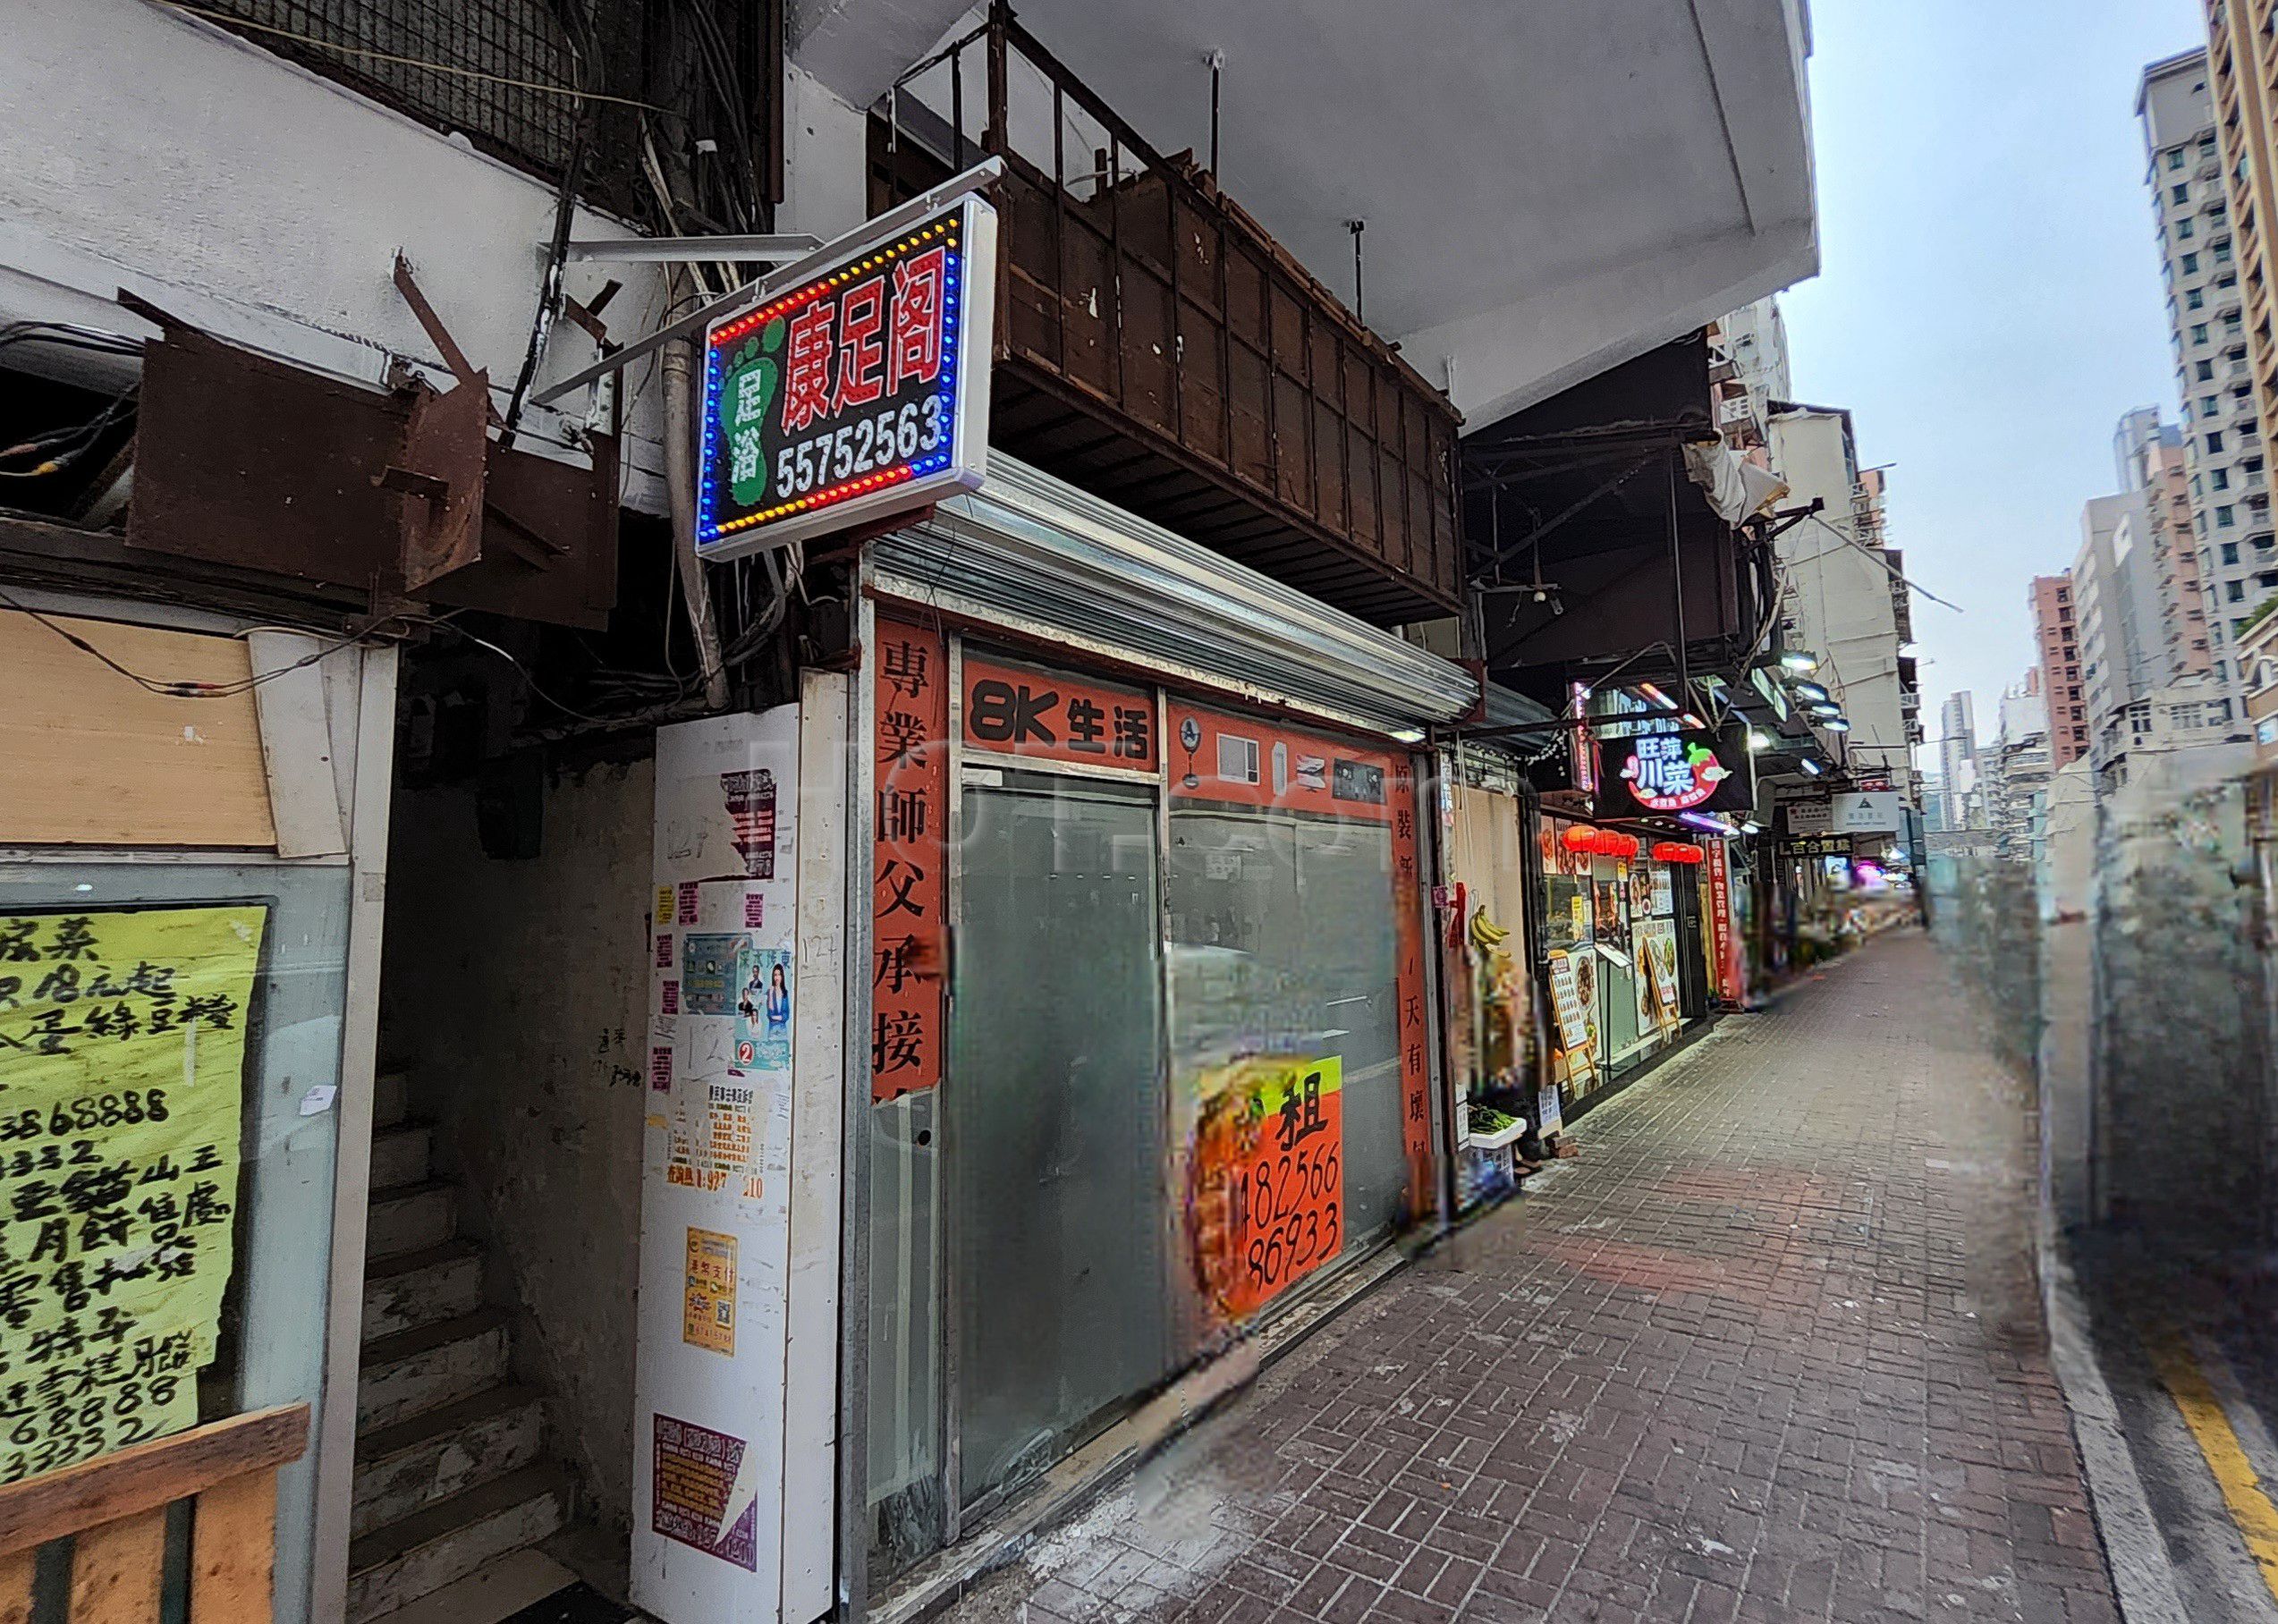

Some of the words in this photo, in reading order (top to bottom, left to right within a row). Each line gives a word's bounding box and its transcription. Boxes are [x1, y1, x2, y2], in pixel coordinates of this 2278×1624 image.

[776, 394, 942, 498] 55752563
[1637, 760, 1695, 795] 川菜
[872, 640, 928, 1104] 專業師父承接
